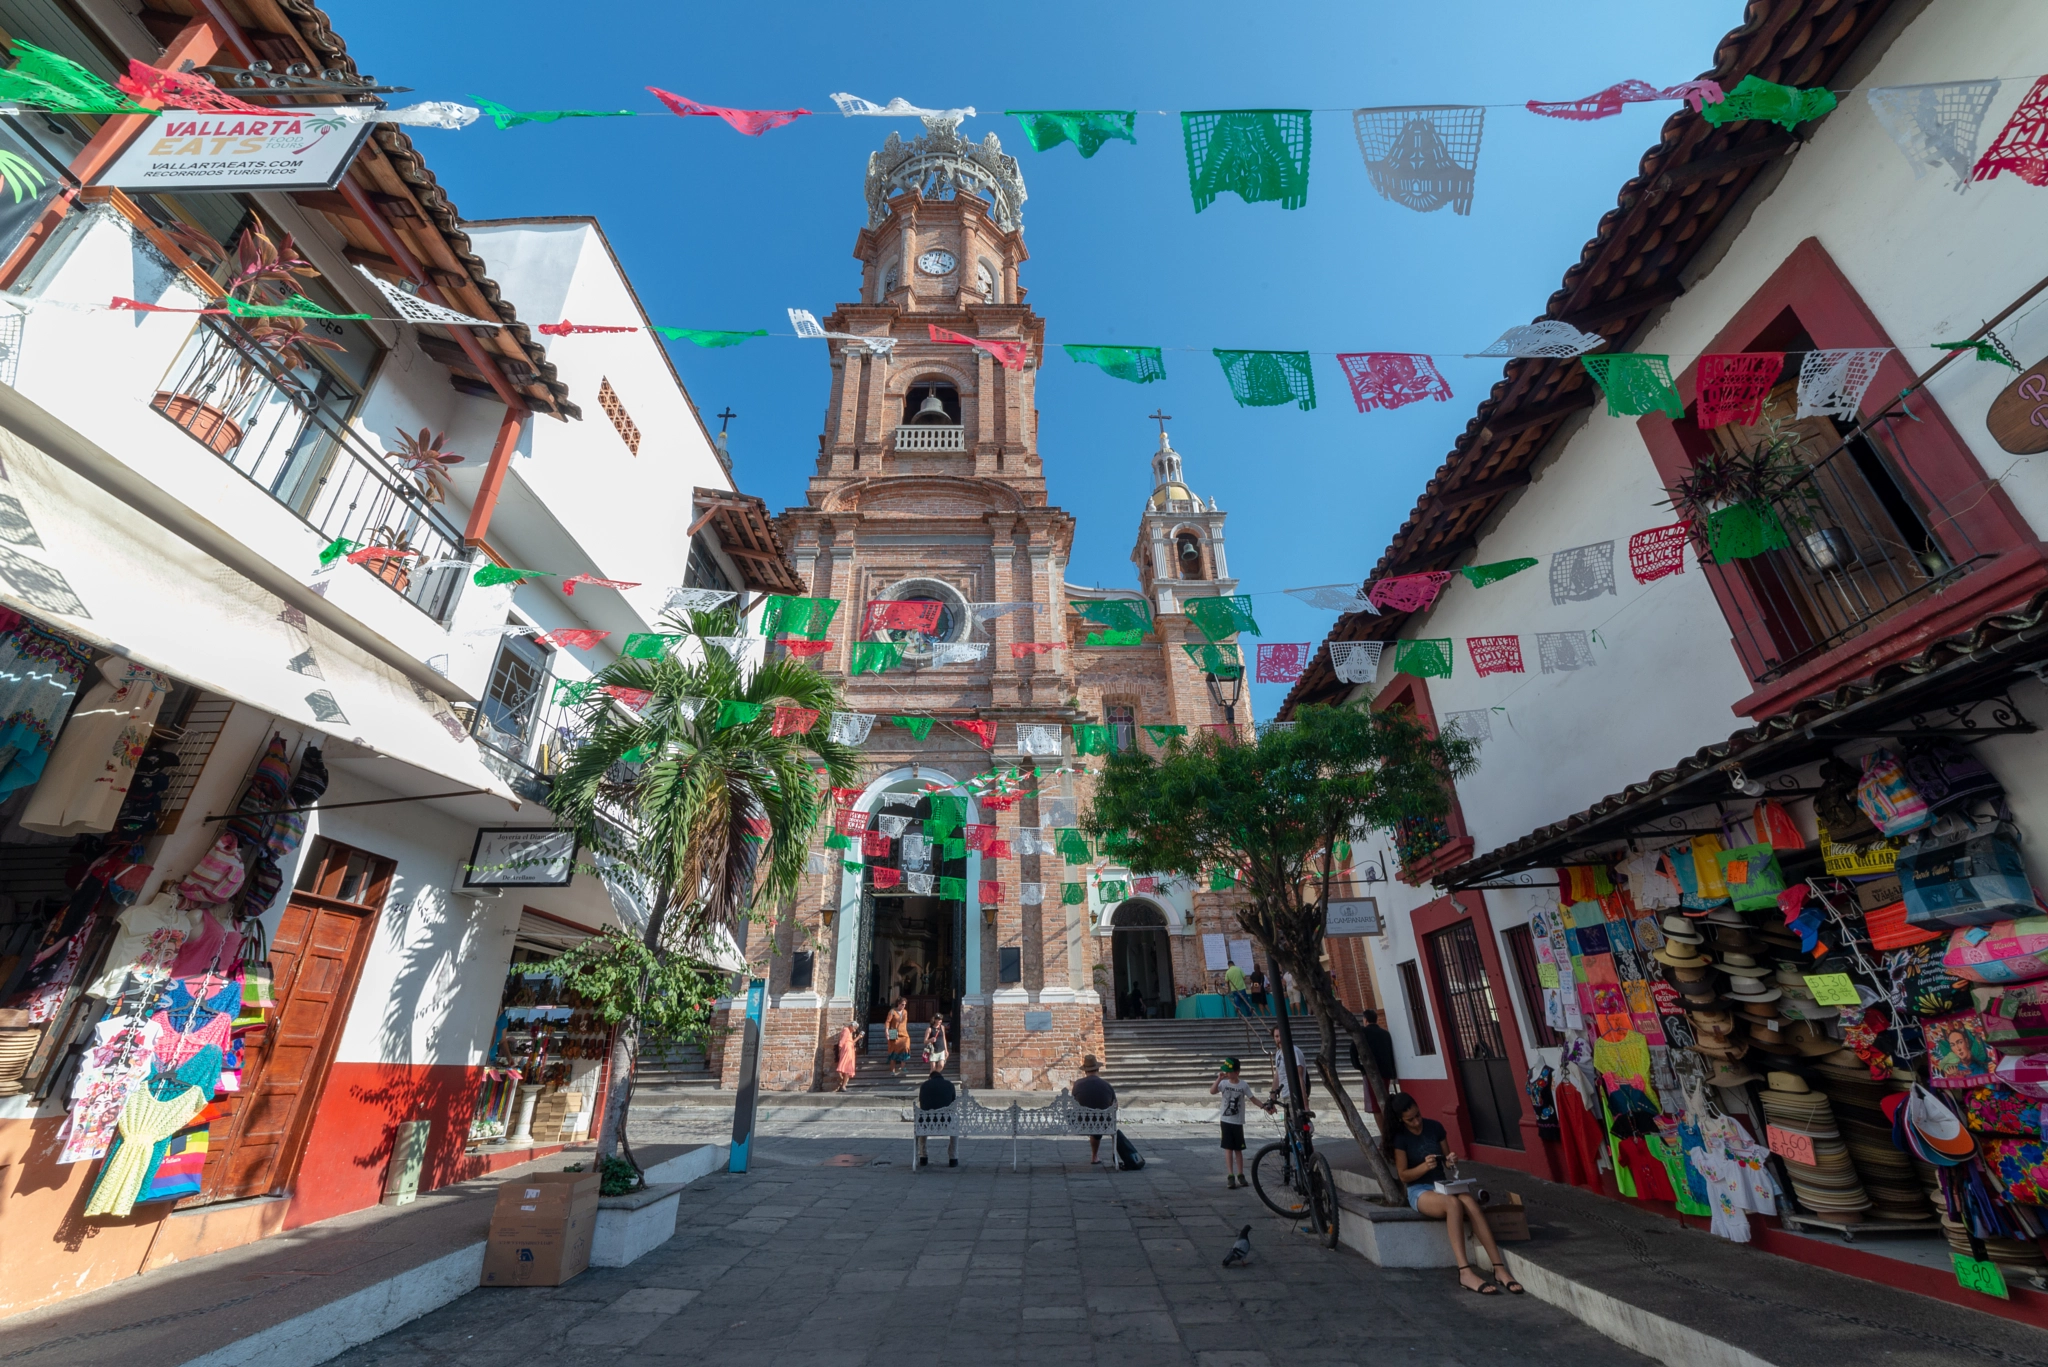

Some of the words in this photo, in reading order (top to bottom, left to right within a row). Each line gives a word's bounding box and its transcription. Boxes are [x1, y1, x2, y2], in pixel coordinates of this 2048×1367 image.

[165, 119, 301, 137] VALLARTA
[148, 136, 268, 156] EATS
[143, 169, 224, 178] RECORRIDOS
[227, 167, 297, 176] TURÍSTICOS
[151, 160, 304, 170] VALLARTAEATS.COM
[1631, 529, 1669, 548] REYNA
[1632, 546, 1681, 567] MEXICO
[1333, 916, 1377, 925] CAMPANARIO
